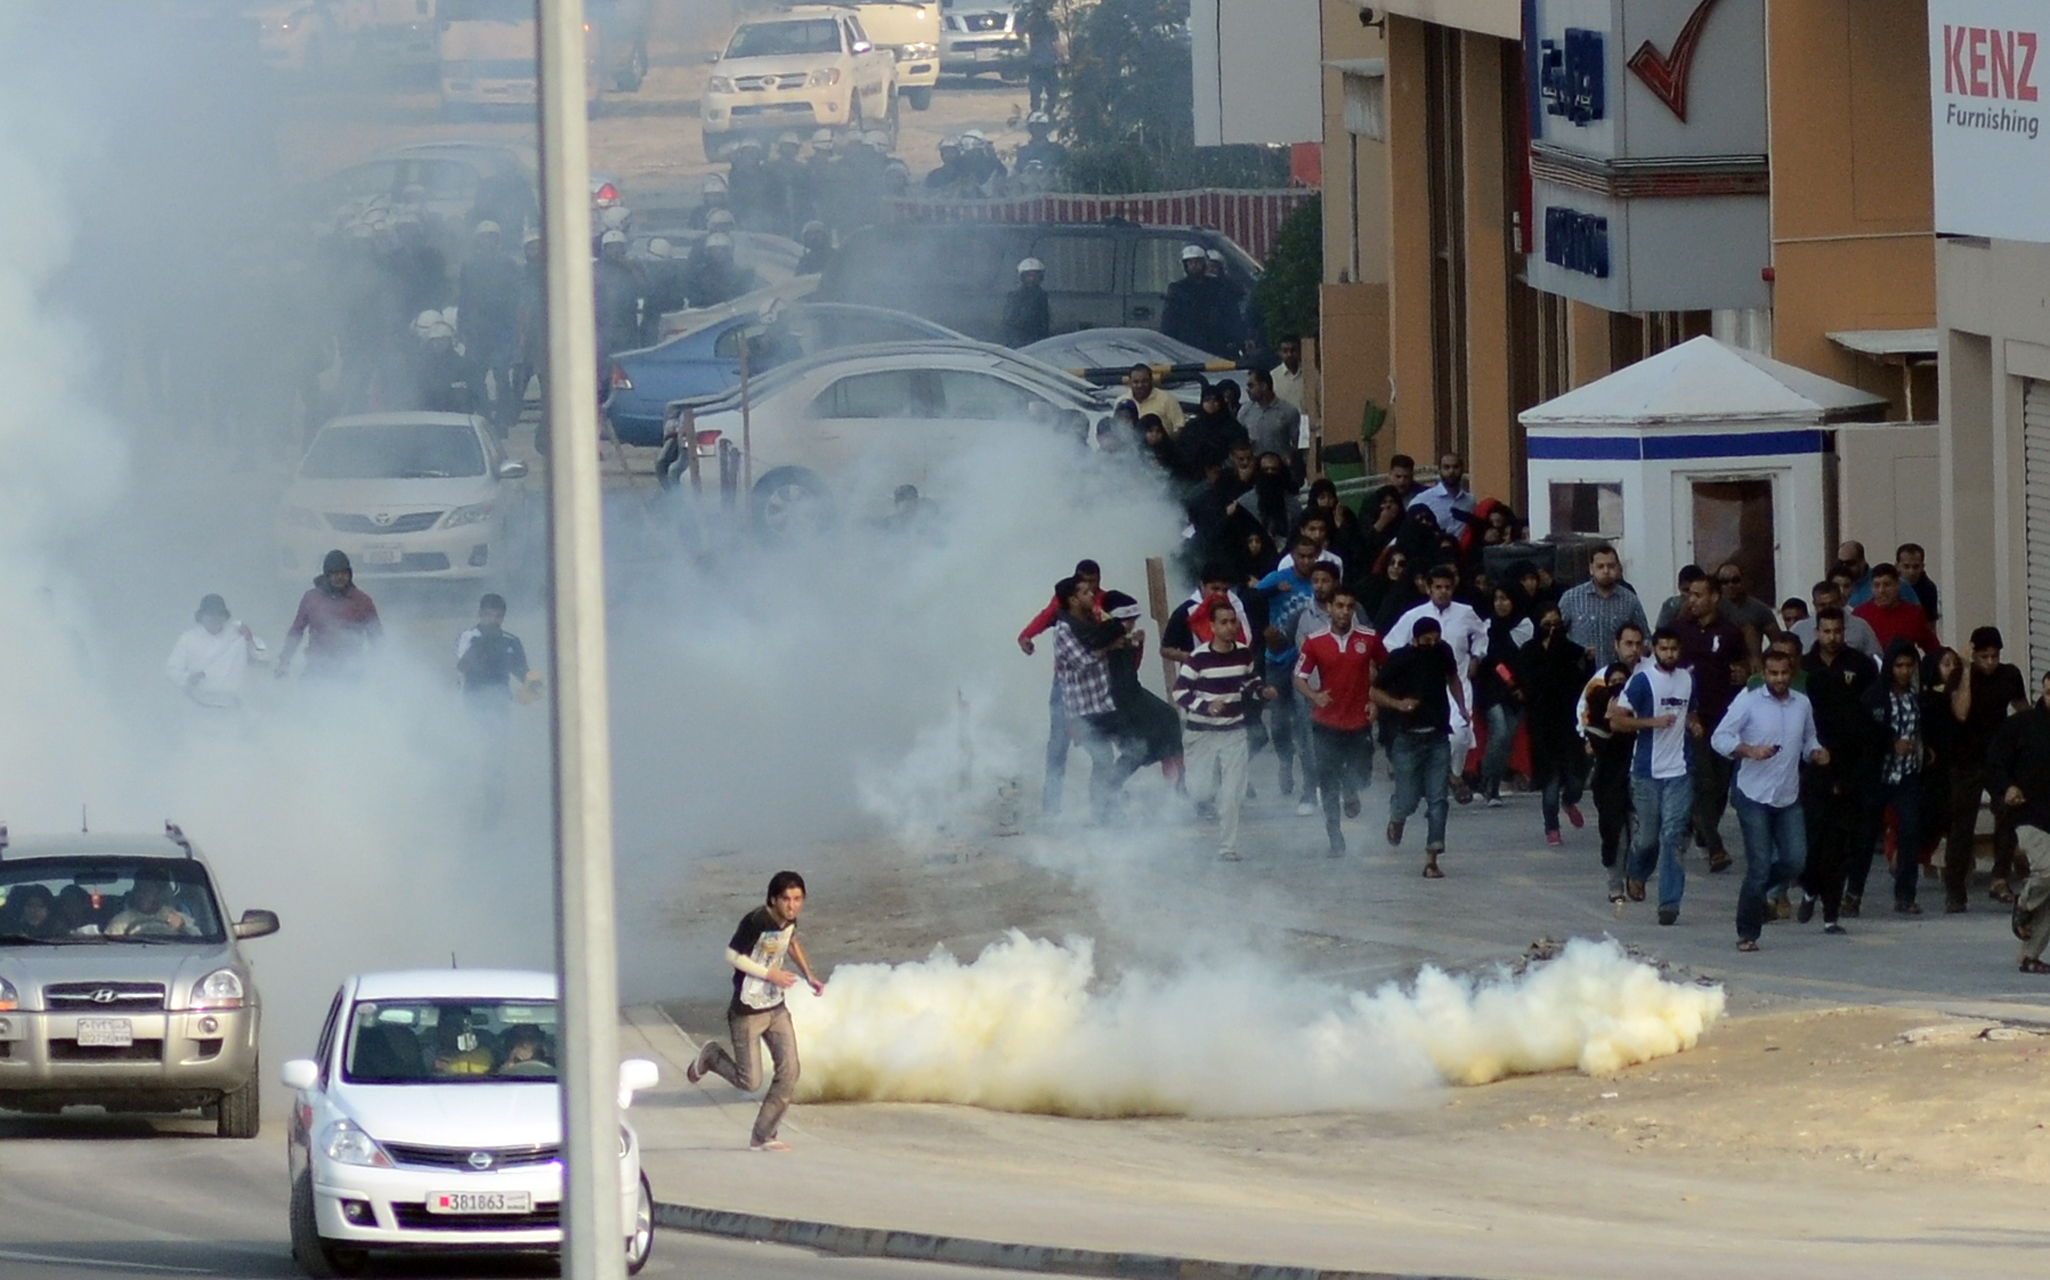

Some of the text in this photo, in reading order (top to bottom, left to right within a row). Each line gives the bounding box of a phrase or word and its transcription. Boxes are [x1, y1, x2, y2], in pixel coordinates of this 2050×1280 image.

[1944, 24, 2038, 102] KENZ
[1947, 103, 2039, 140] Furnishing
[450, 1194, 504, 1211] 381863
